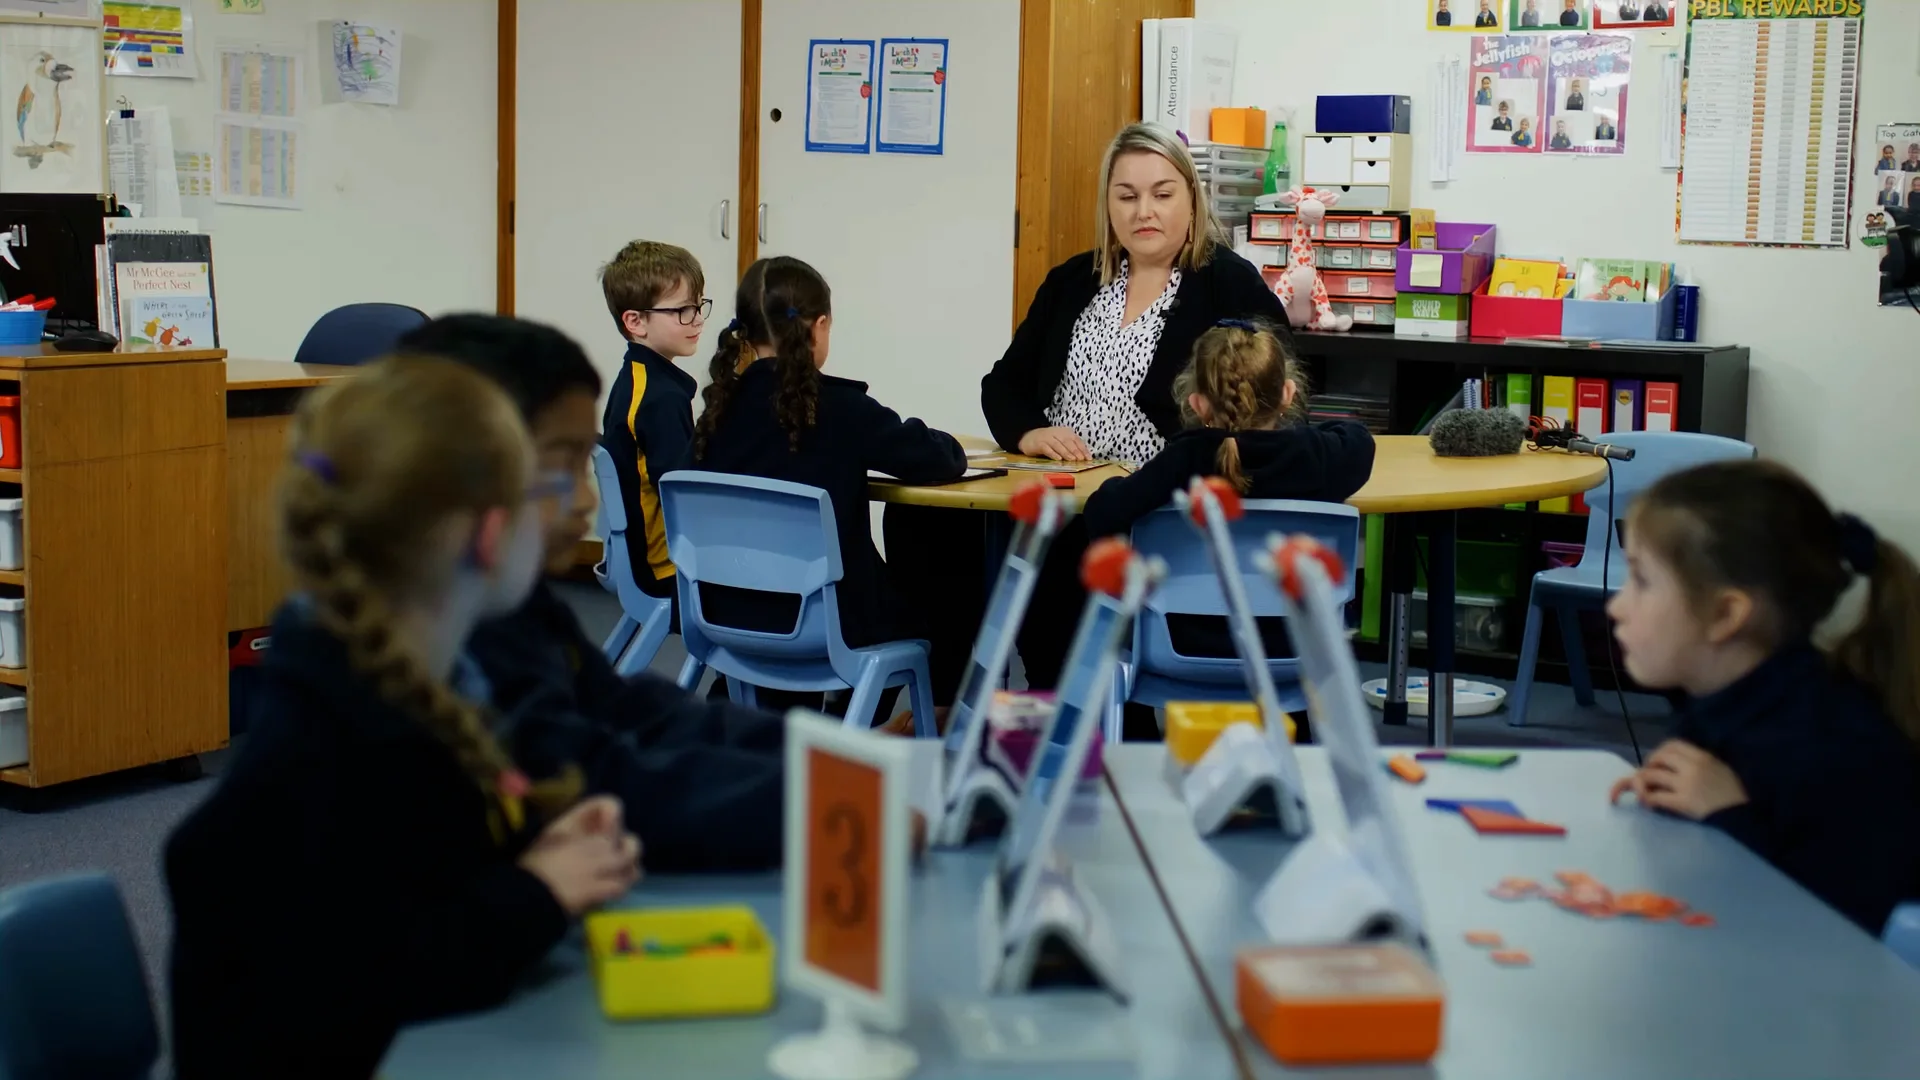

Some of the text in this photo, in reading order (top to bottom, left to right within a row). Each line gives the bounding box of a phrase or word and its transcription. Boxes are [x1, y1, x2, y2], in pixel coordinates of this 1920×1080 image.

[1690, 0, 1862, 16] PBL REWARDS
[1472, 41, 1530, 67] Jellyfish
[1167, 46, 1178, 117] Attendance
[1882, 129, 1920, 139] Top Gat
[126, 267, 138, 277] Mr
[140, 266, 175, 278] McGee
[133, 279, 191, 290] Perfect Nest
[1412, 300, 1441, 310] SOUND
[823, 801, 868, 928] 3
